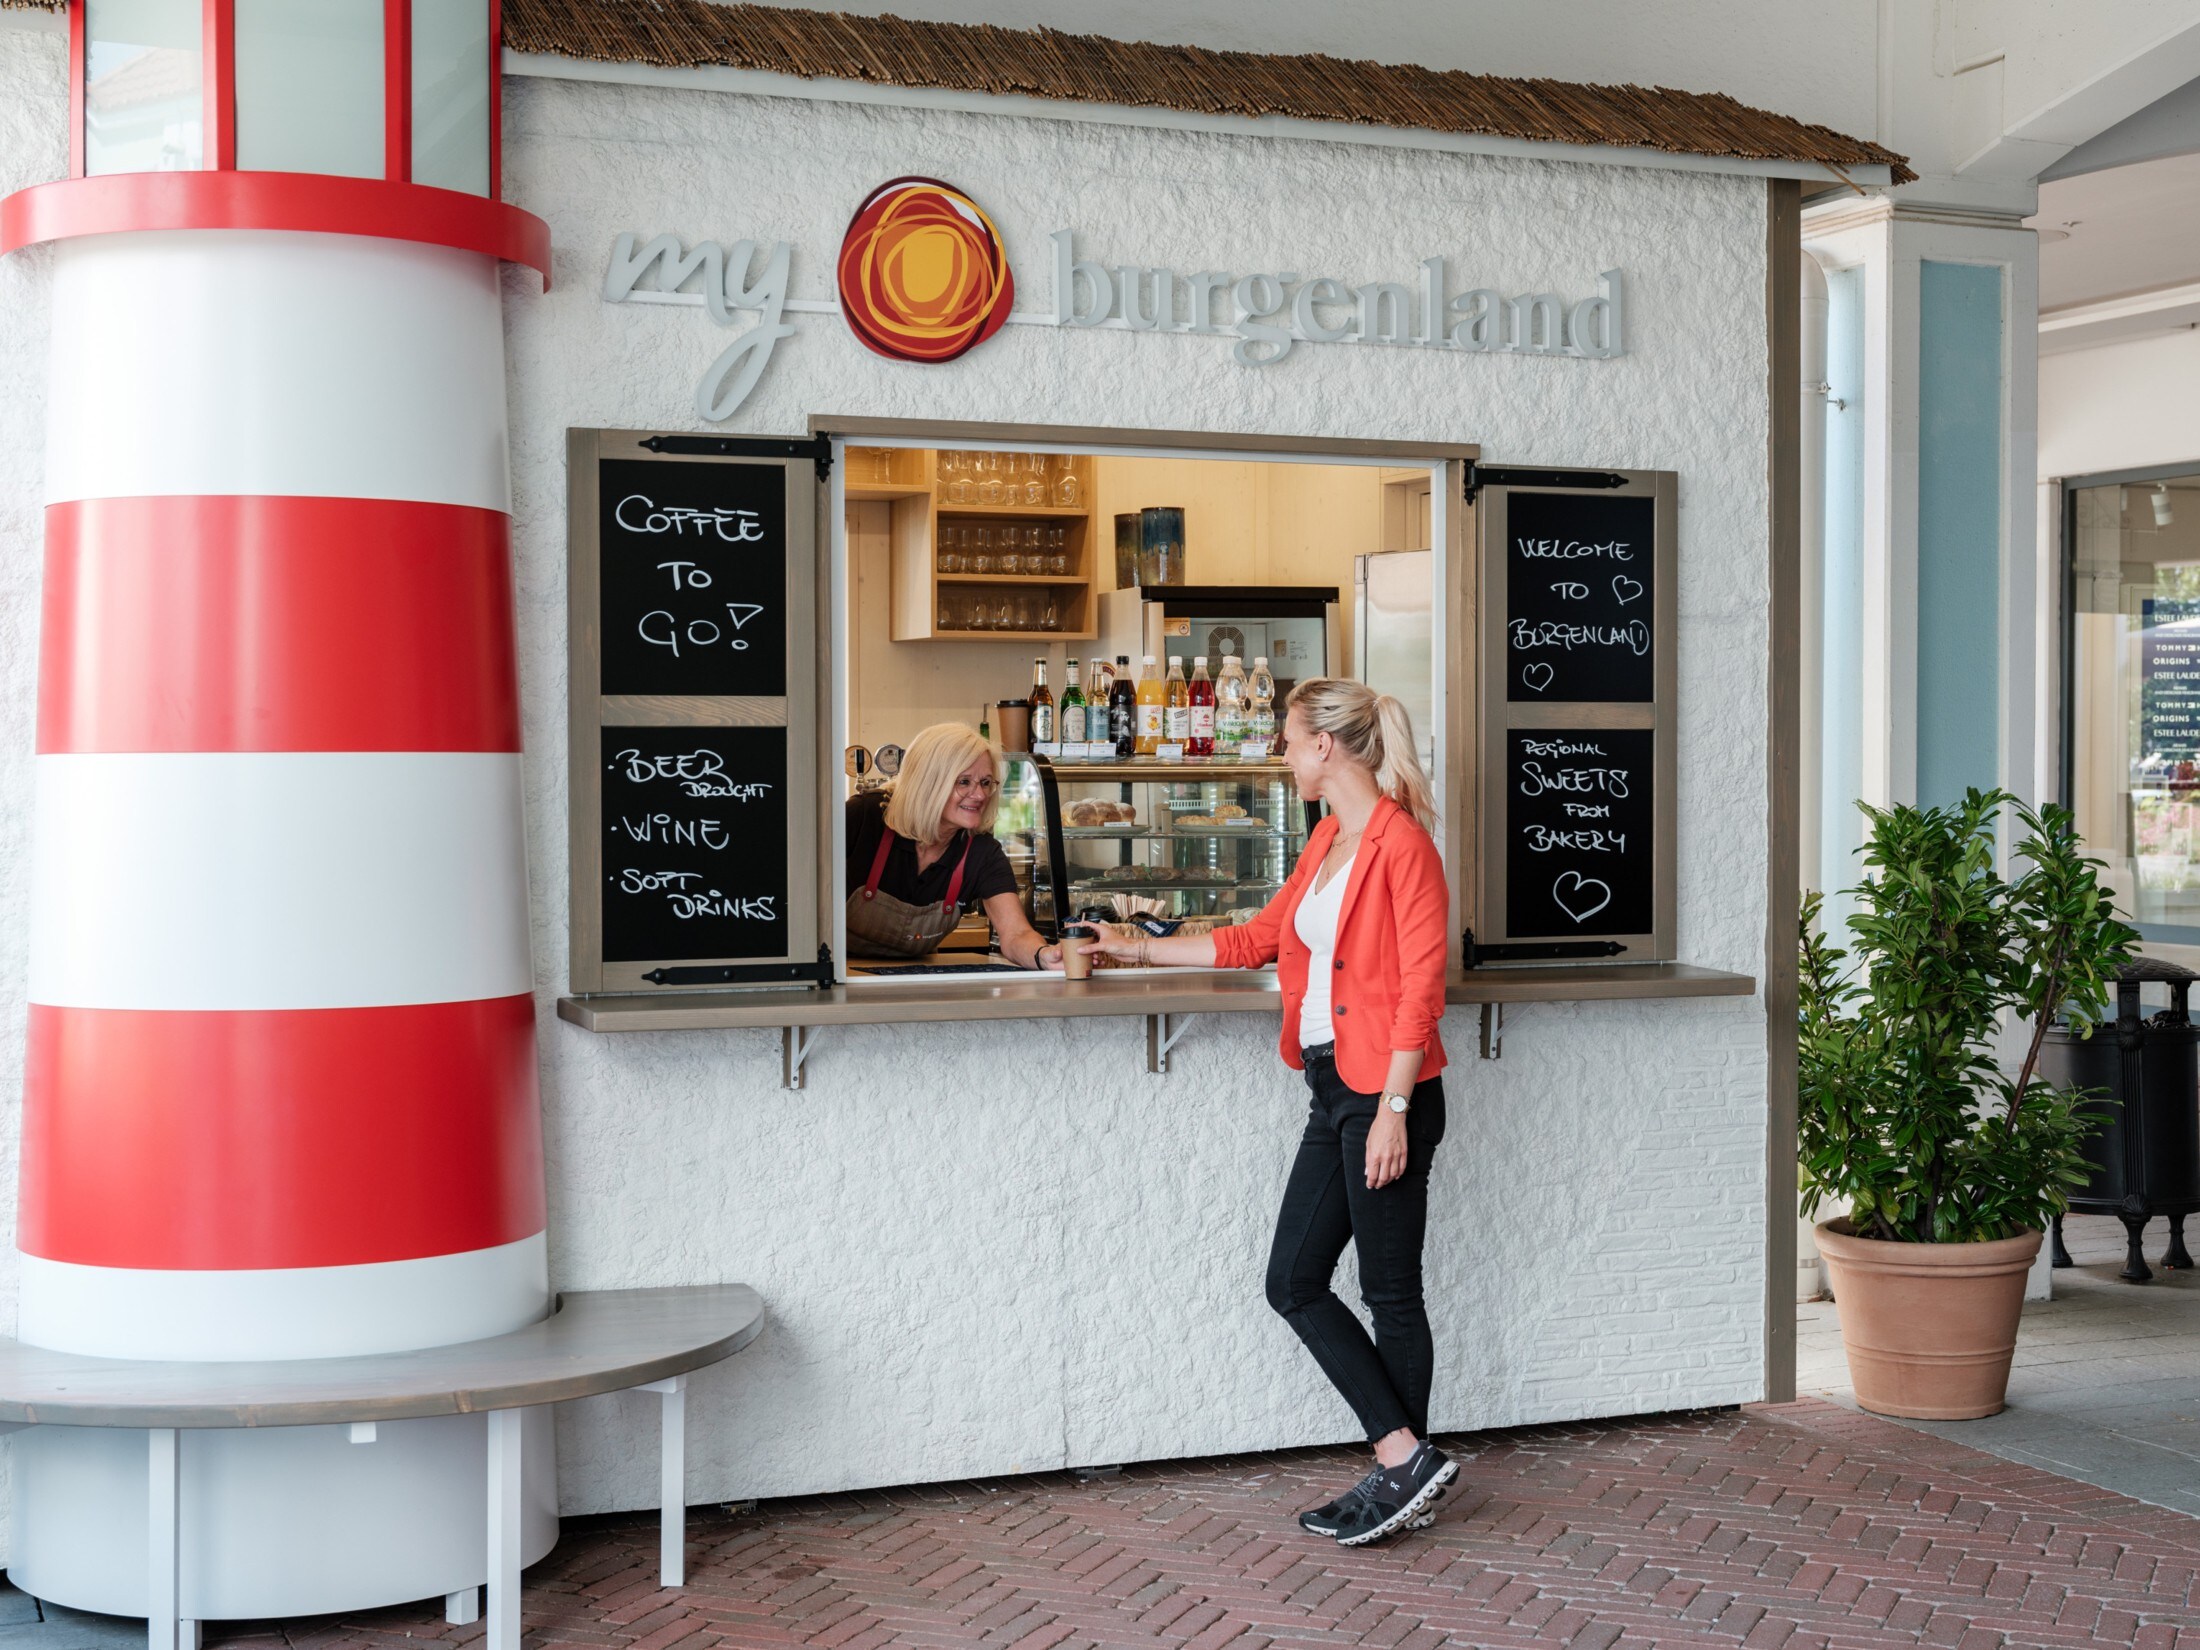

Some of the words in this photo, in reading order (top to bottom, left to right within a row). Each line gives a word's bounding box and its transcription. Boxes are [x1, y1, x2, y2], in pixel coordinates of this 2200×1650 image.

[606, 231, 797, 423] my
[1049, 228, 1625, 368] burgenland
[1517, 537, 1634, 561] WELCOME
[656, 561, 713, 591] TO
[1550, 581, 1590, 600] TO
[638, 602, 764, 658] GO!
[1508, 618, 1650, 656] BURGENLAND
[2155, 644, 2187, 652] TOMMY
[2152, 657, 2191, 666] ORIGINS
[2155, 701, 2187, 709] TOMMY
[2152, 714, 2190, 723] ORIGINS
[615, 748, 734, 783] BEER
[1520, 761, 1629, 799] SWEETS
[1562, 802, 1610, 818] FROM
[1523, 824, 1626, 854] BAKERY
[620, 868, 703, 894] SOFT
